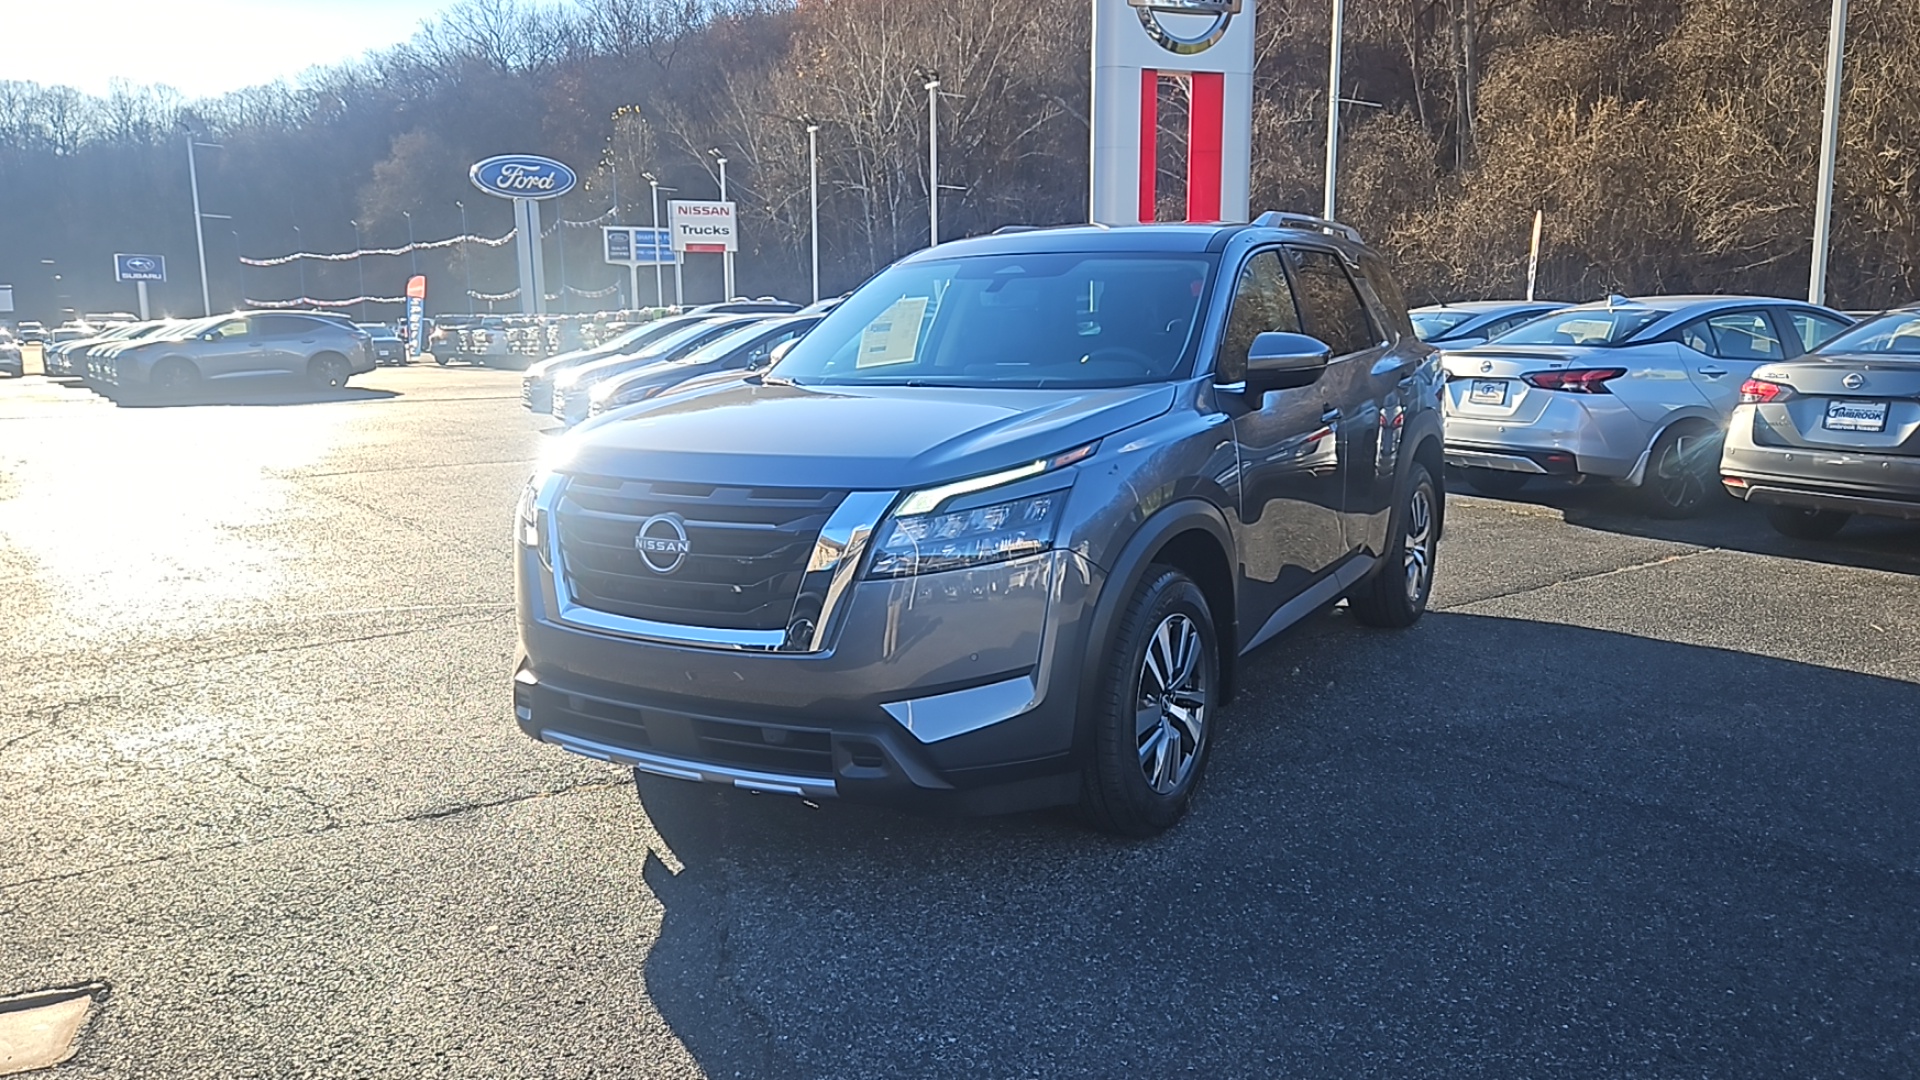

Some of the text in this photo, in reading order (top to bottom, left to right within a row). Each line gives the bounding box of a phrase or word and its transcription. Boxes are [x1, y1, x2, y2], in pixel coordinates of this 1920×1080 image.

[496, 163, 556, 190] Ford
[678, 205, 730, 217] NISSAN
[679, 224, 730, 235] Trucks
[121, 272, 163, 280] SUBARU
[635, 538, 689, 553] NISSAN
